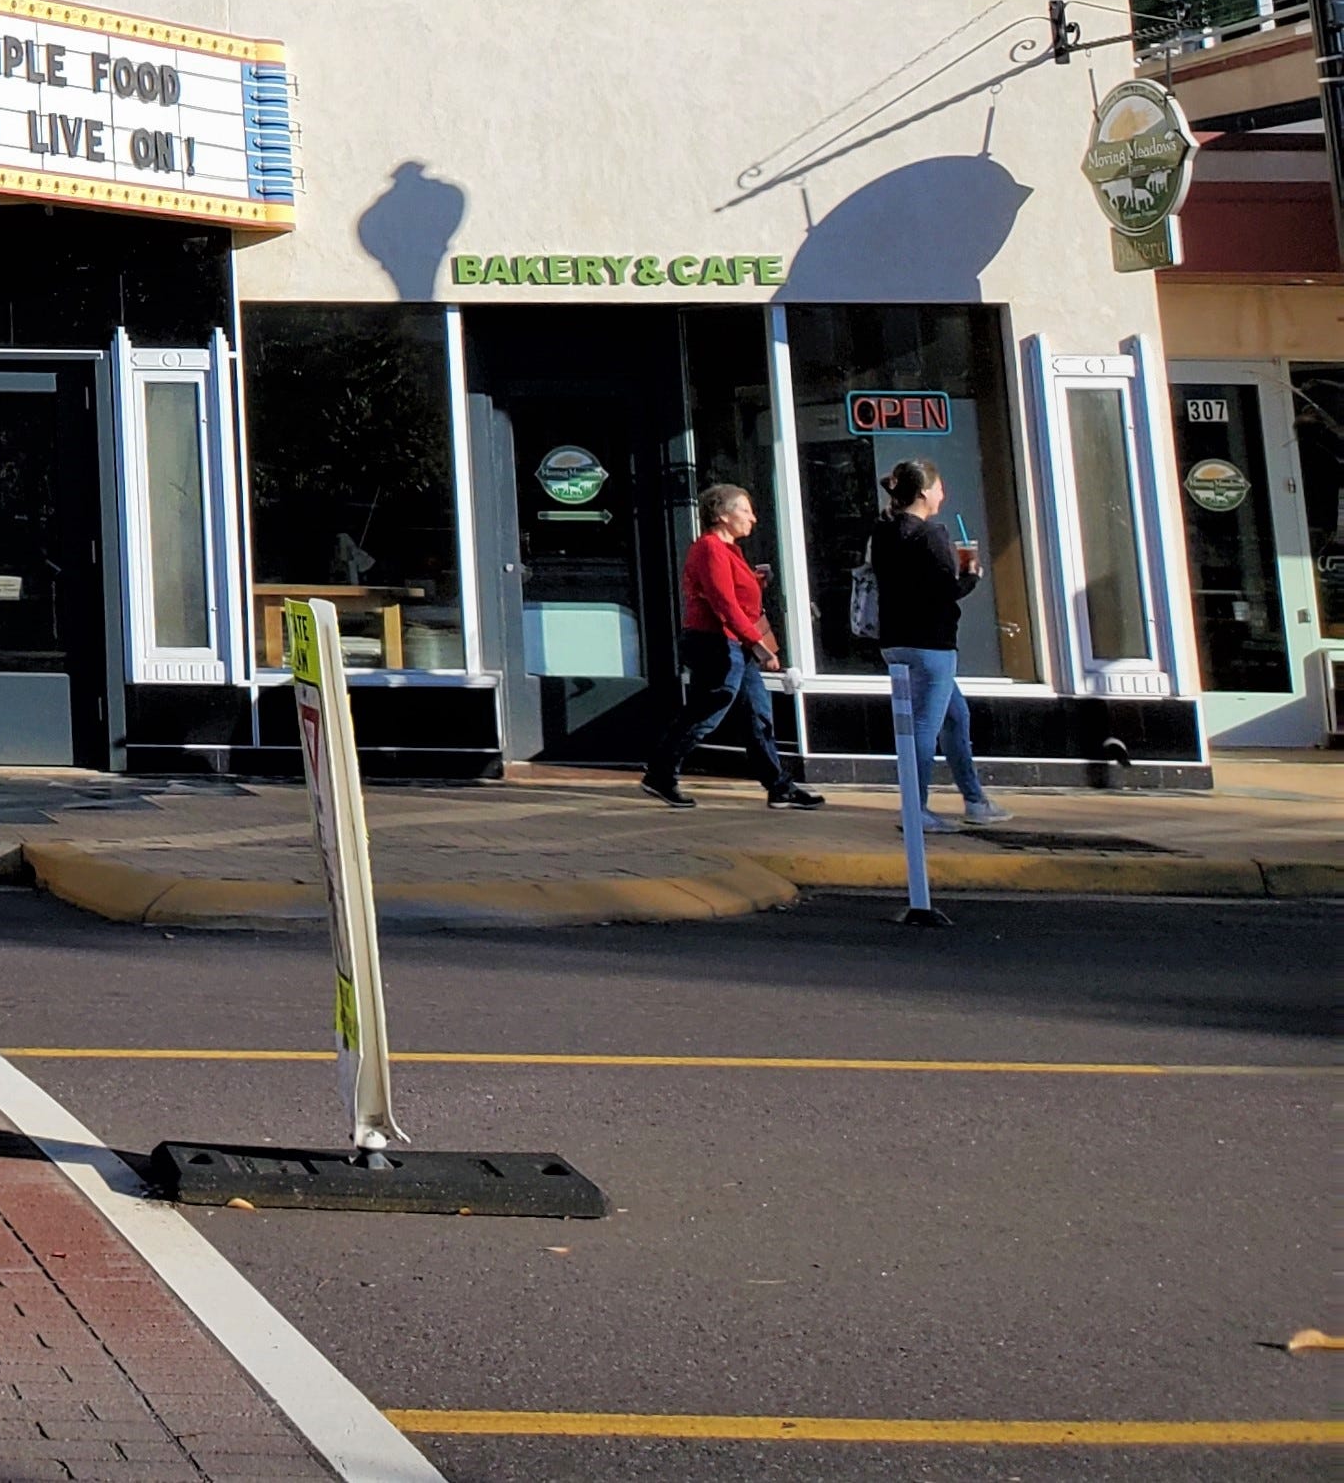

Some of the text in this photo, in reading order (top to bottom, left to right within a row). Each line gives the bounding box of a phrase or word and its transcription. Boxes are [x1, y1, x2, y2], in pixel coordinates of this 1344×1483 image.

[91, 51, 181, 106] FOOD
[27, 110, 105, 162] LIVE
[1088, 138, 1177, 170] Moving Meadows
[1116, 240, 1167, 263] Bakery
[853, 397, 948, 429] OPEN
[1190, 401, 1225, 421] 307
